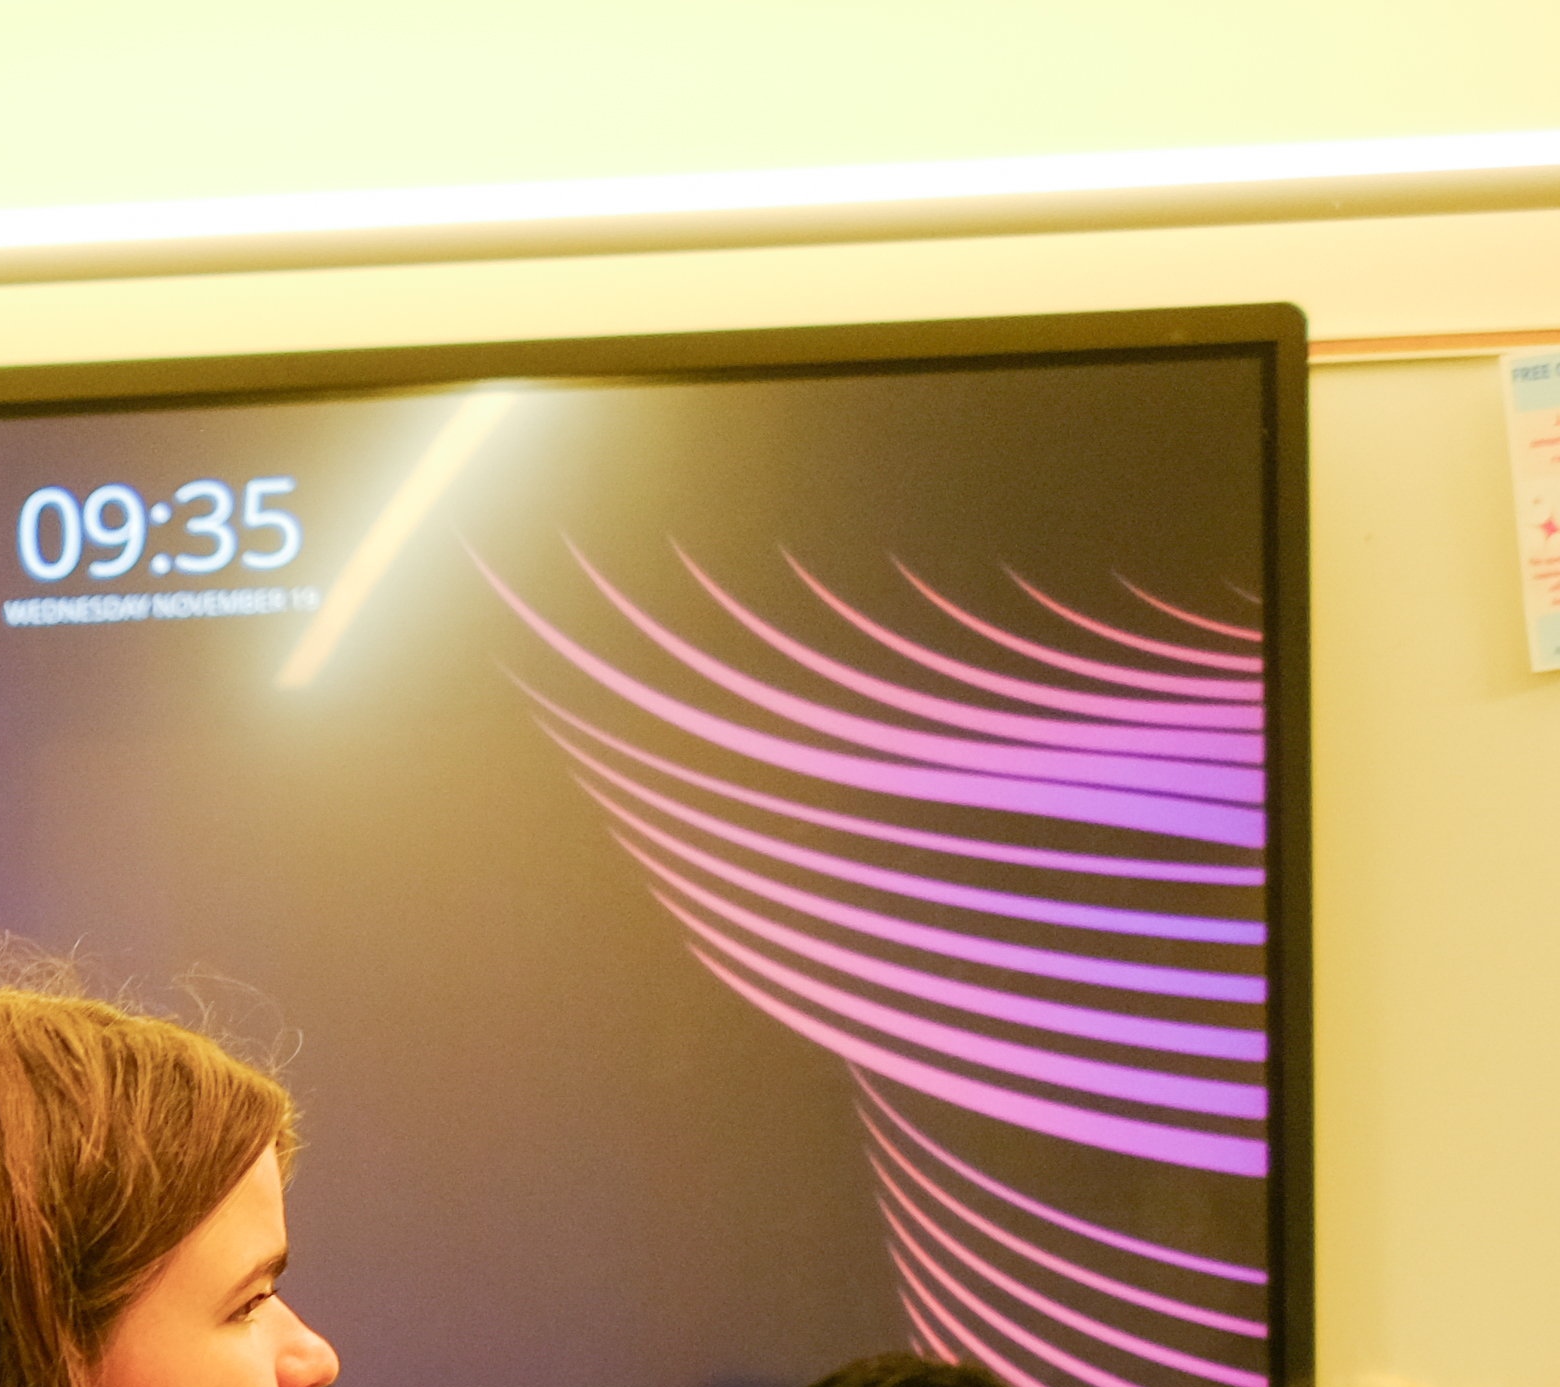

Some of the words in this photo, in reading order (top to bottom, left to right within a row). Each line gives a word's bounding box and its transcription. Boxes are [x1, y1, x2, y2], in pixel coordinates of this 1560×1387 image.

[17, 474, 304, 583] 09:35
[2, 593, 151, 628] WEDNESDAY
[151, 587, 287, 620] NOVEMBER
